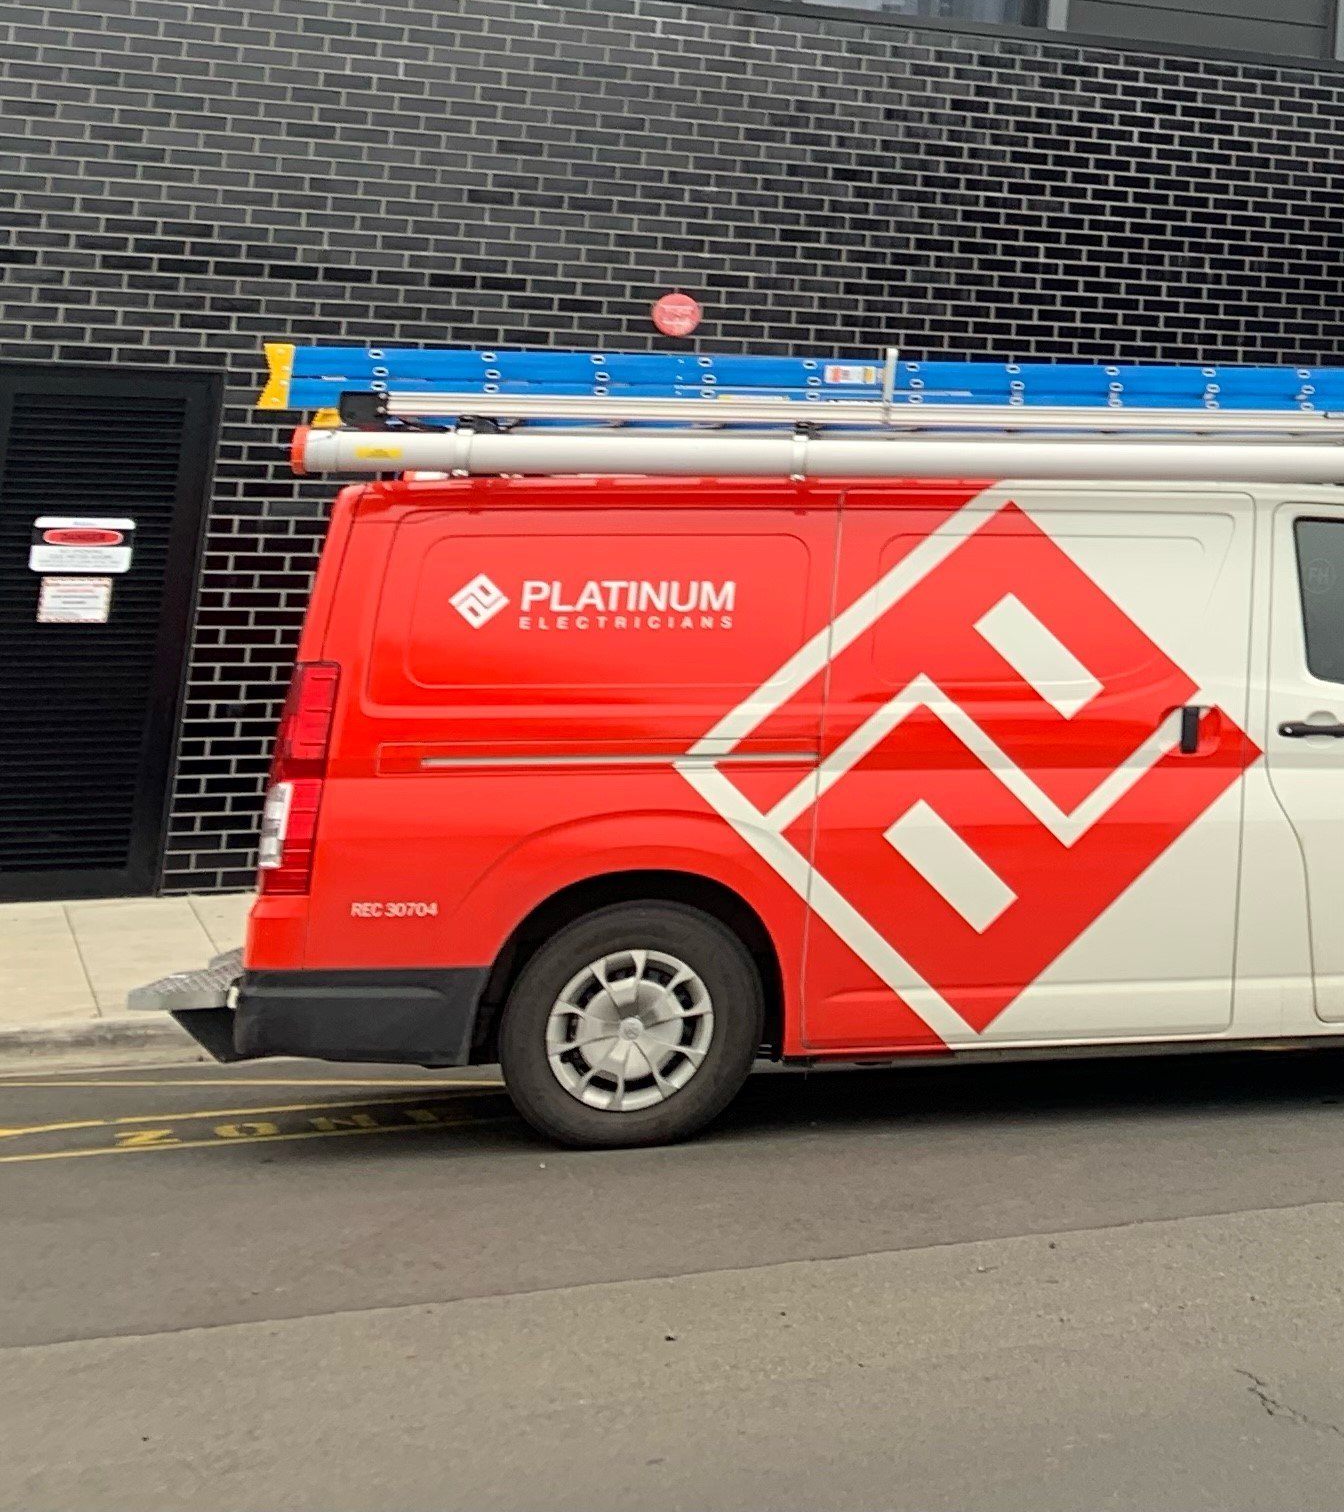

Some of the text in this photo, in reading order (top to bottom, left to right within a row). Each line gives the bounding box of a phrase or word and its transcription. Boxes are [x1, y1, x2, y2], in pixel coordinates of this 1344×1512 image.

[520, 580, 737, 612] PLATINUM
[518, 615, 734, 631] ELECTRICIANS
[350, 902, 438, 918] REC 30704
